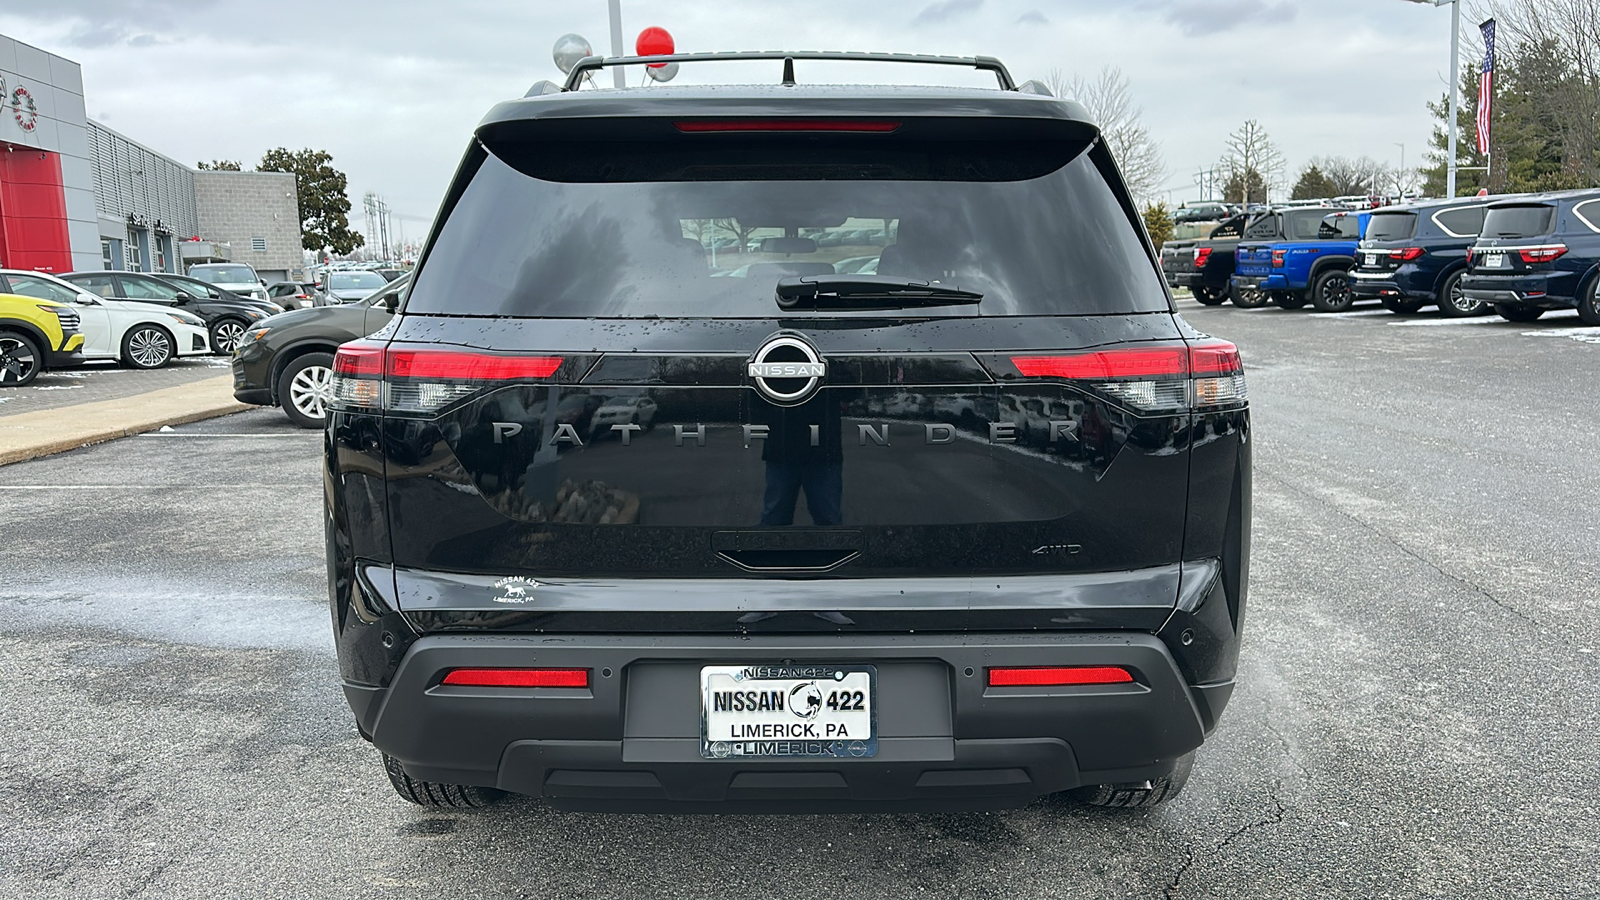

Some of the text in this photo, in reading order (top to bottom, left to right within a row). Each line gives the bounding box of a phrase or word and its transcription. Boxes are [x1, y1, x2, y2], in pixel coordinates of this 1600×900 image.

[750, 366, 823, 376] NISSAN
[492, 421, 1080, 447] PATHFINDER
[1032, 544, 1082, 555] 4WD
[494, 576, 539, 588] NISSAN 422
[743, 667, 834, 678] NISSAN 422
[714, 691, 865, 712] NISSAN 422
[731, 724, 849, 738] LIMERICK, PA
[742, 741, 835, 756] LIMERICK
